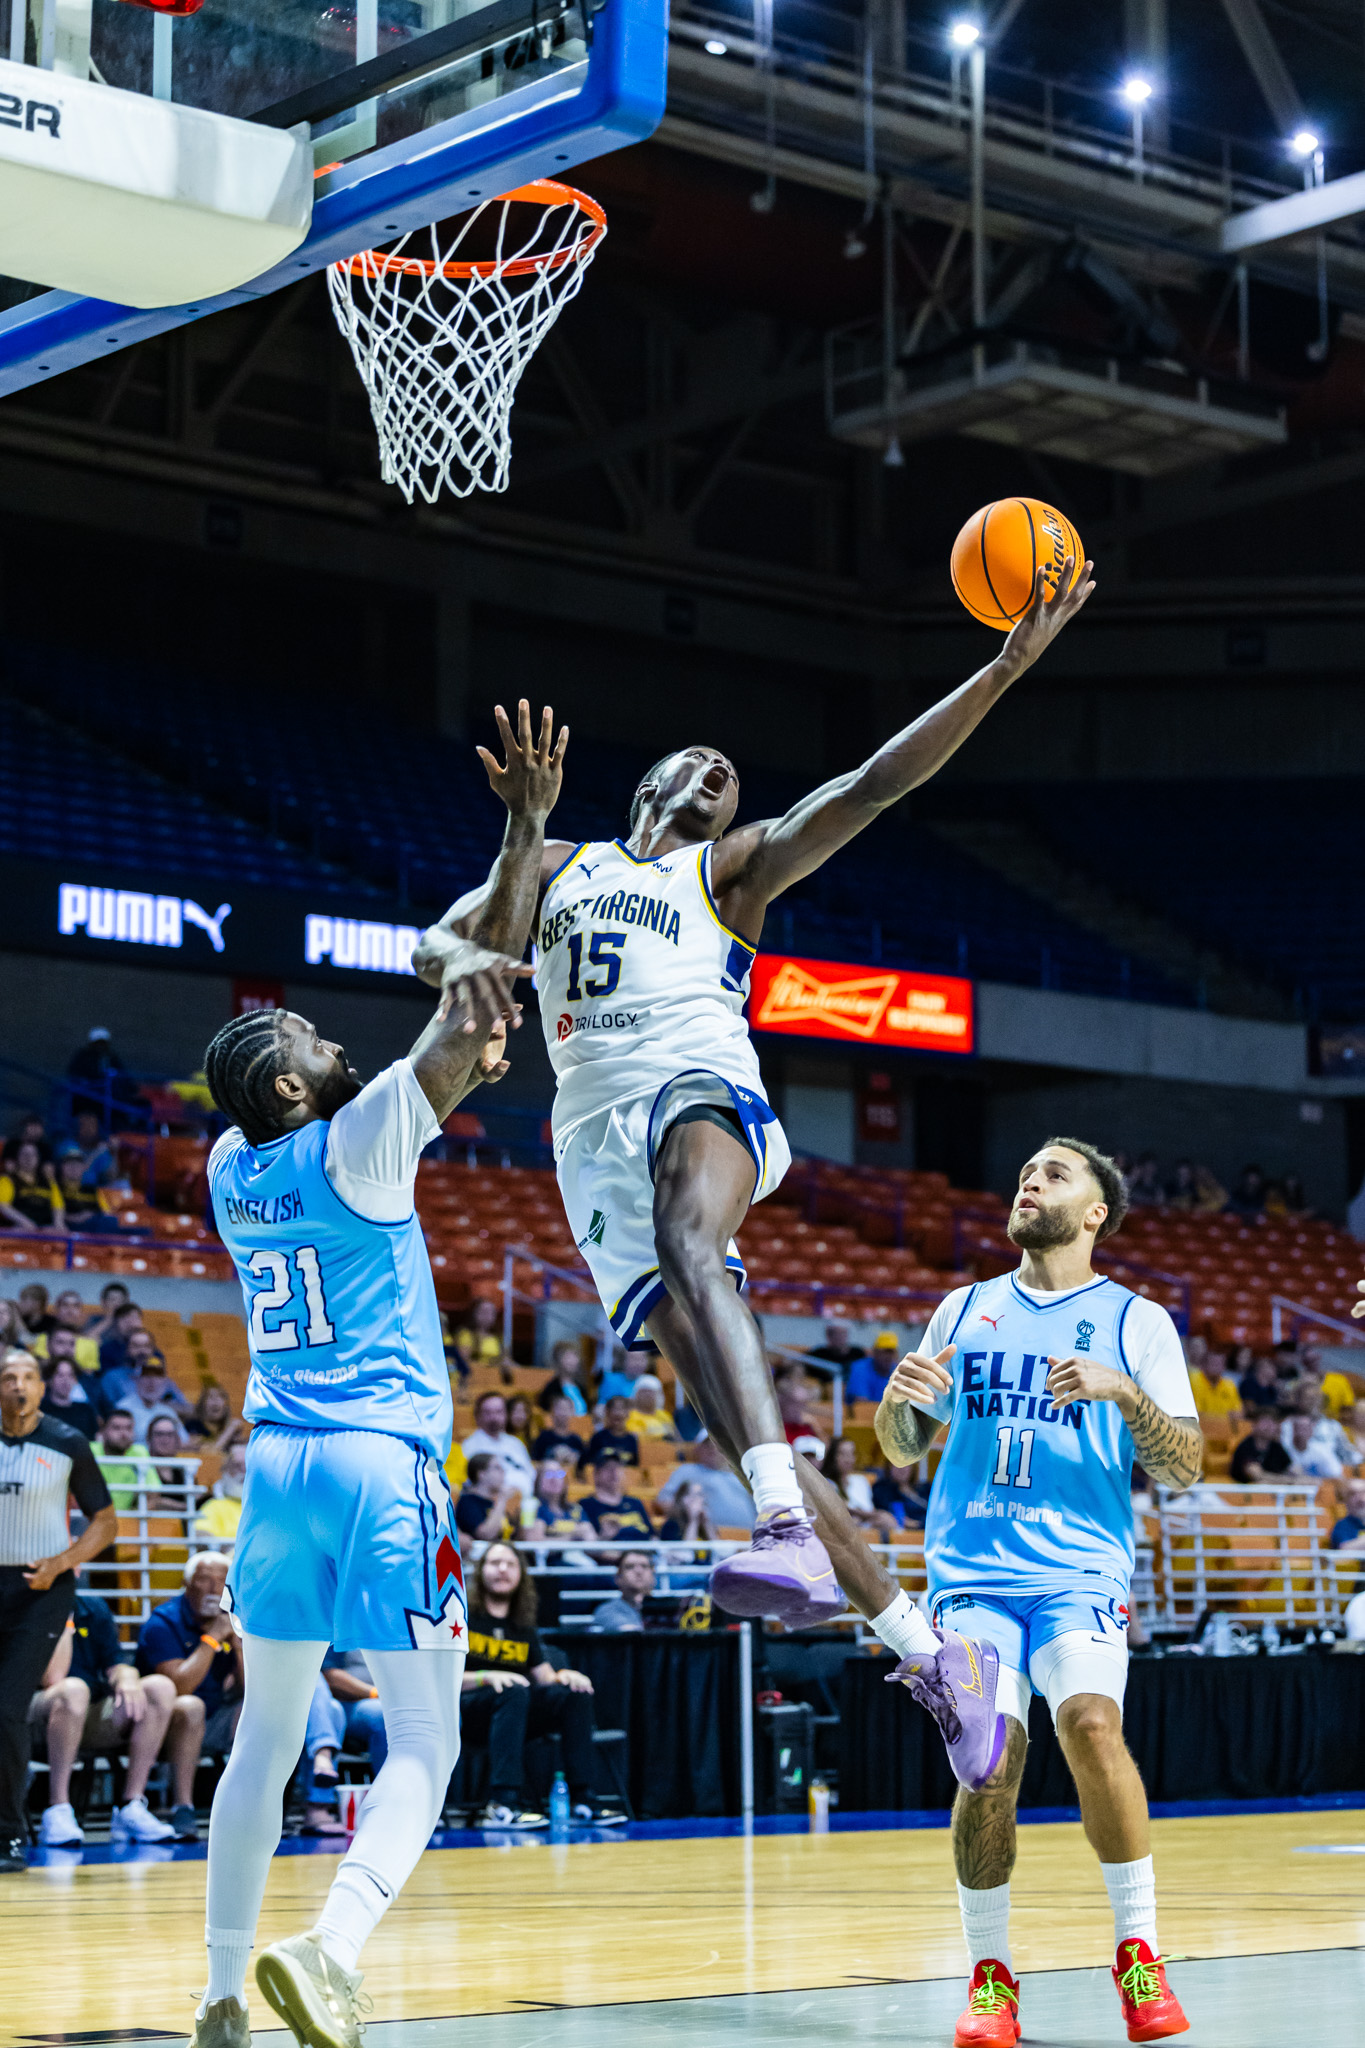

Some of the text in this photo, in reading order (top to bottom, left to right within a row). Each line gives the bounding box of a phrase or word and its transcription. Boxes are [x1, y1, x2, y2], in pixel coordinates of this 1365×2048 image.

[58, 882, 184, 948] PUMA
[305, 913, 424, 976] PUMA
[567, 931, 628, 1002] 15
[225, 1188, 304, 1225] ENGLISH
[247, 1244, 338, 1353] 21
[961, 1351, 1091, 1408] ELI
[965, 1393, 1085, 1430] NATION
[992, 1426, 1036, 1489] 11
[1007, 1501, 1063, 1526] Pharma
[468, 1630, 530, 1663] WVSU
